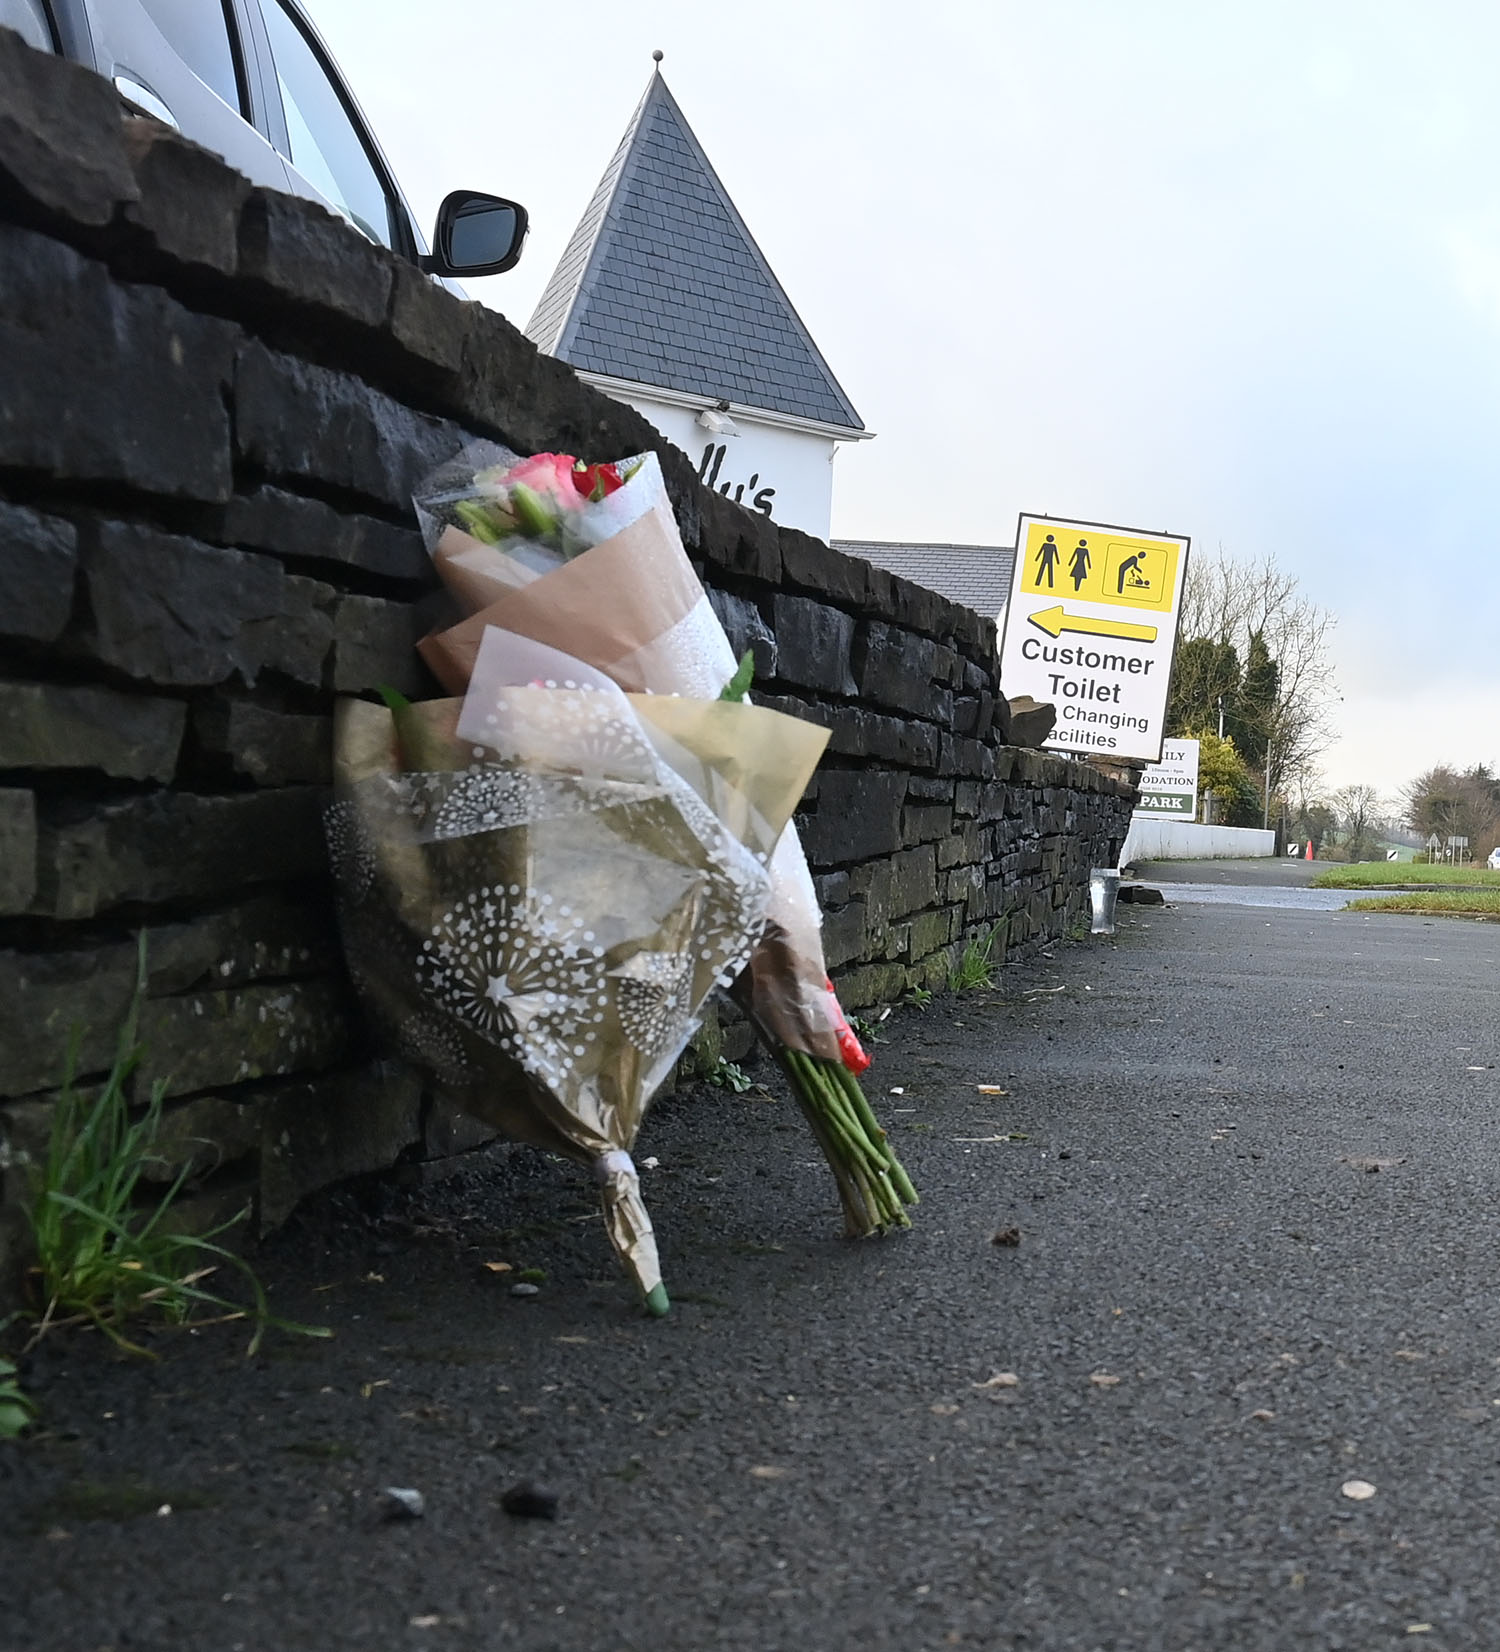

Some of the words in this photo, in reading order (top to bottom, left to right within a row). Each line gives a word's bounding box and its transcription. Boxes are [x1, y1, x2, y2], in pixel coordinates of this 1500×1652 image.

[1021, 638, 1154, 675] Customer
[1047, 673, 1121, 704] Toilet
[1063, 705, 1149, 733] Changing
[1048, 728, 1117, 748] acilities
[1162, 751, 1186, 761] ILY
[1142, 776, 1194, 785] ODATION
[1140, 795, 1183, 809] PARK
